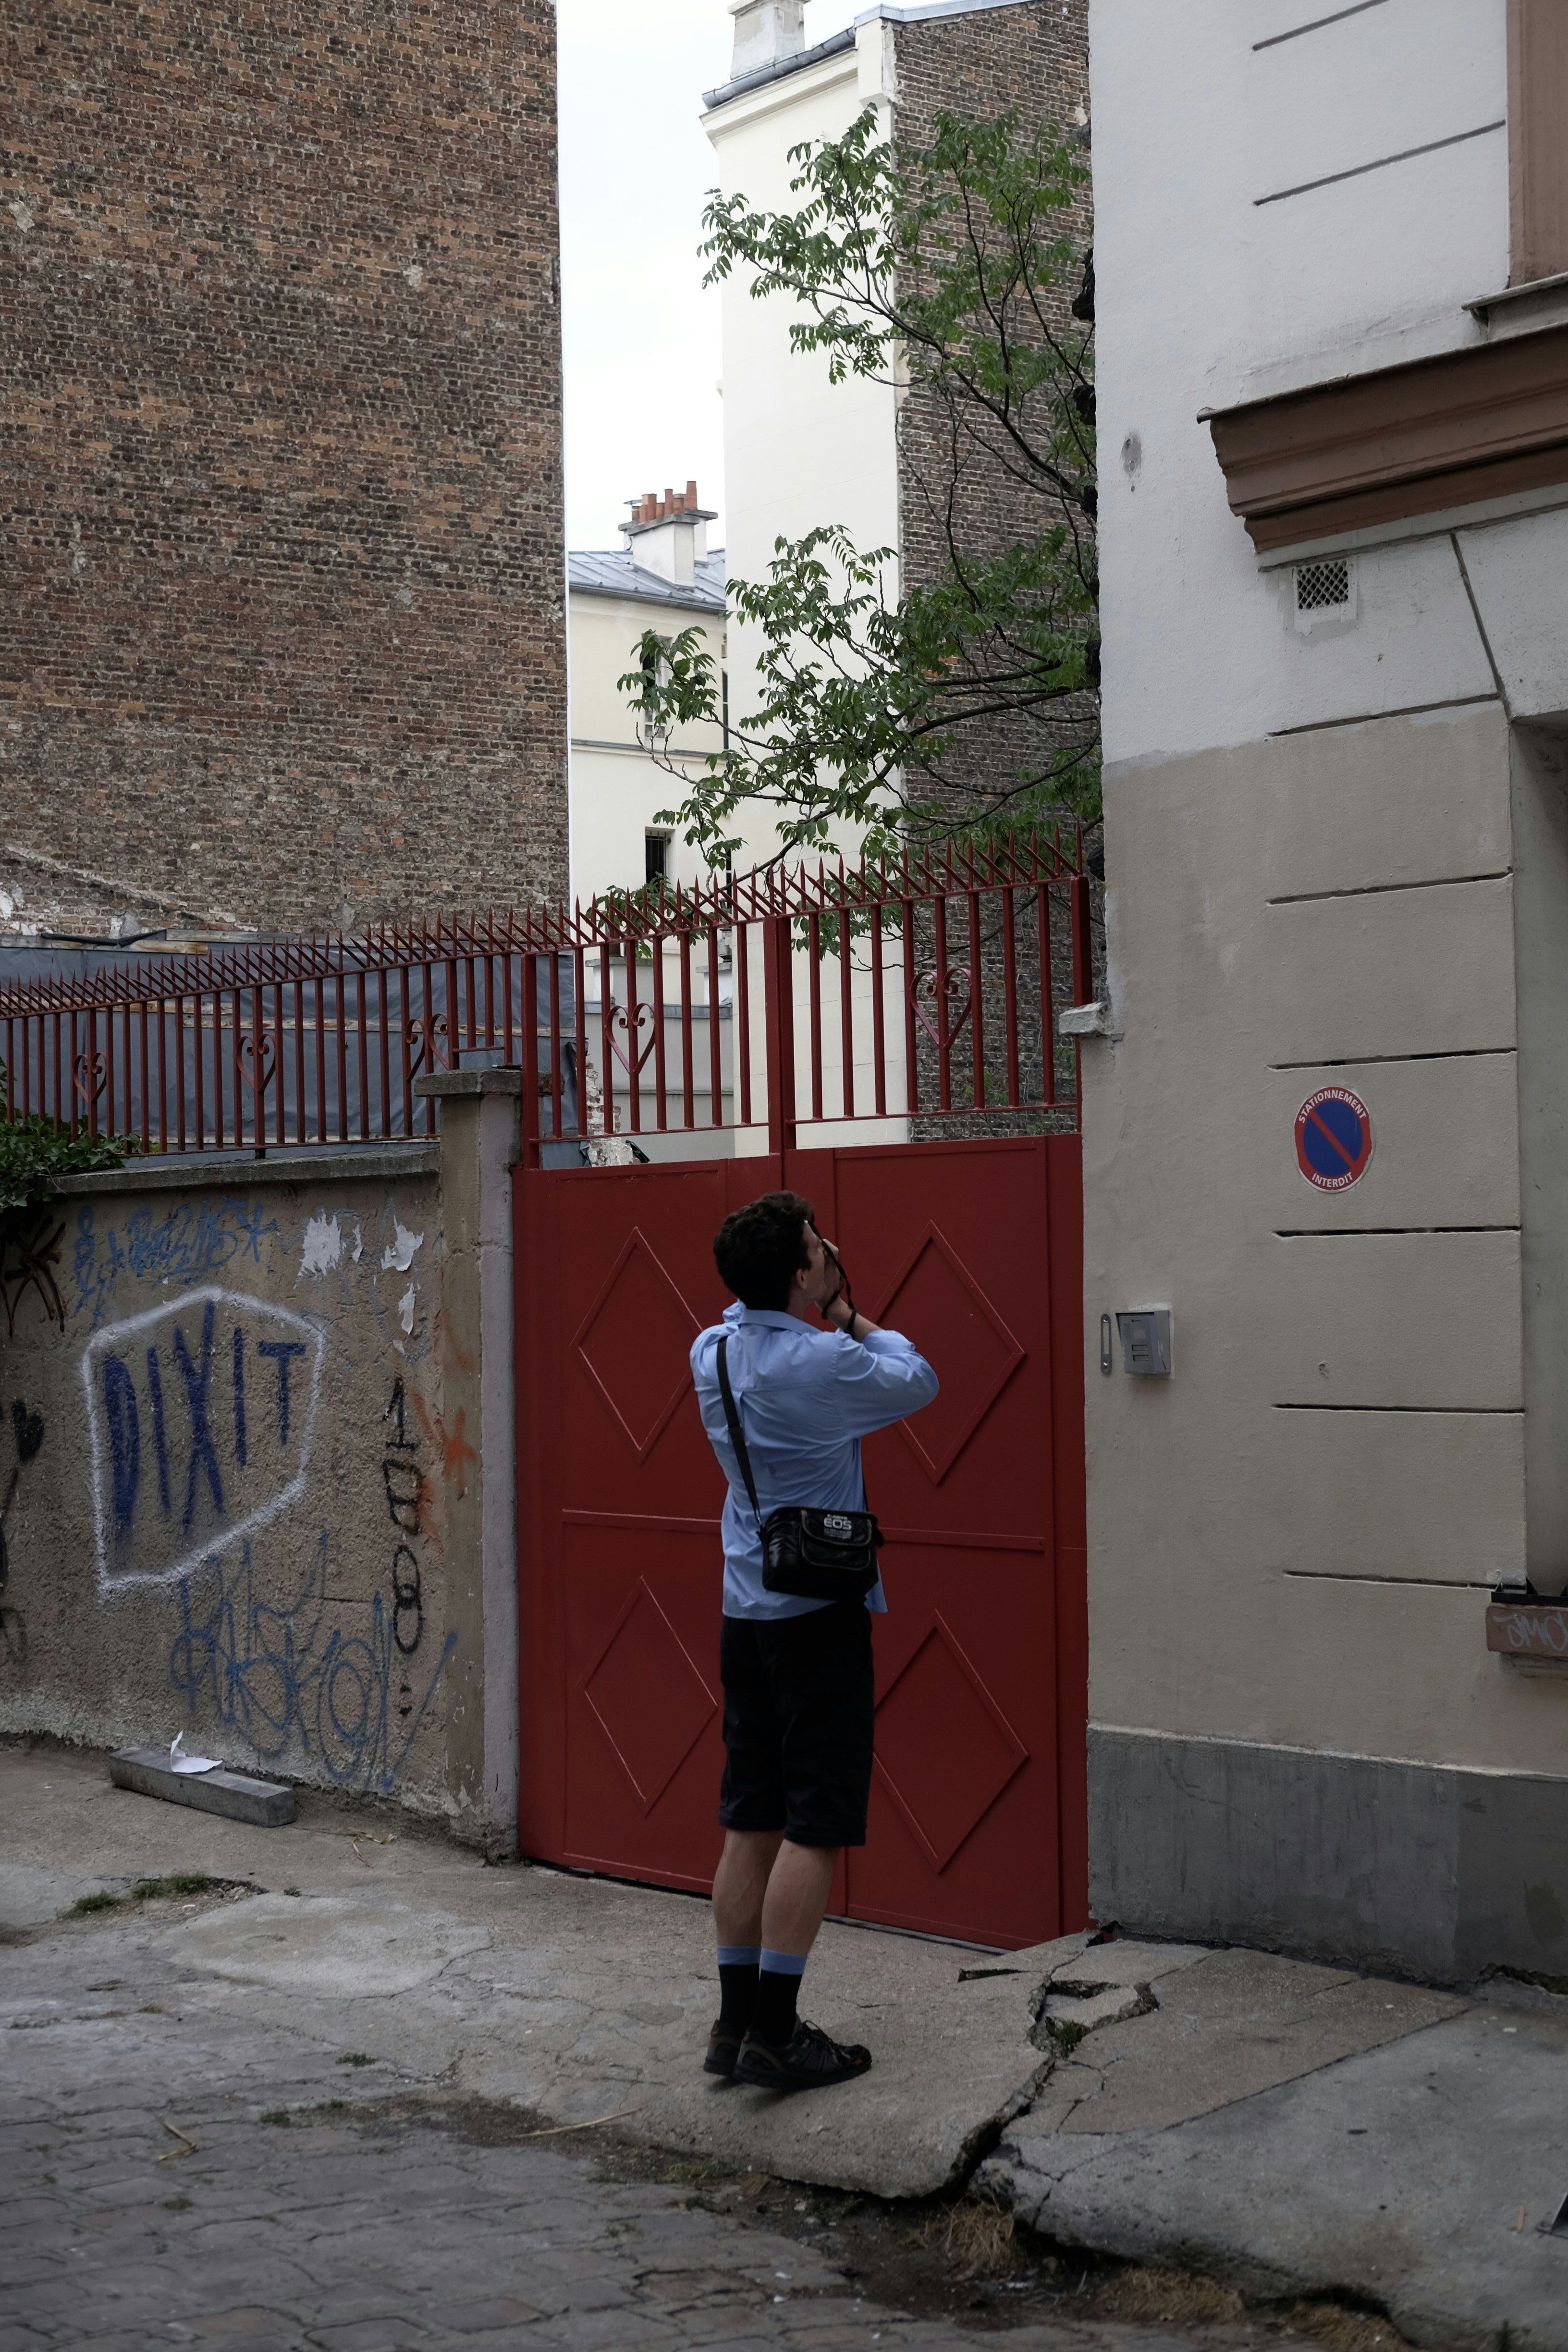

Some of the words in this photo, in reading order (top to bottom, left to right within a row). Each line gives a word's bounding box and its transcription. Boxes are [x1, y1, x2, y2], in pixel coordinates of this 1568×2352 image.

[1298, 1090, 1367, 1123] STATIONNEMENT
[1311, 1172, 1354, 1188] INTERDIT
[823, 1517, 852, 1531] EOS
